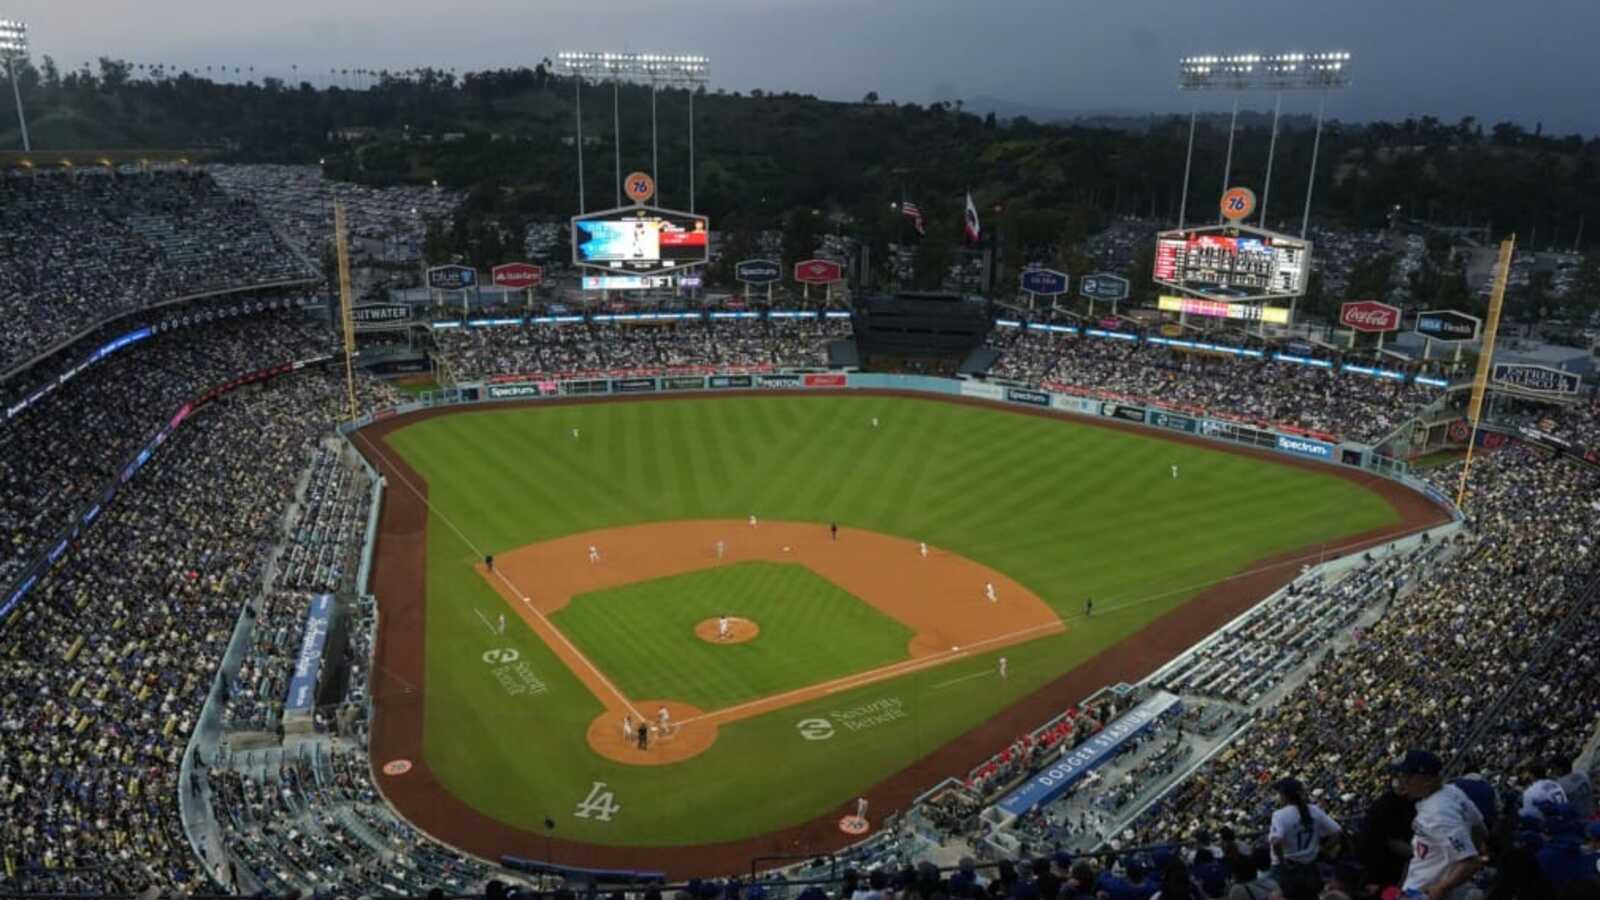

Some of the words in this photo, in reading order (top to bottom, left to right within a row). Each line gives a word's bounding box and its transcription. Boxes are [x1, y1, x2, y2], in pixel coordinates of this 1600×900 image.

[633, 180, 648, 194] 76
[1229, 196, 1245, 211] 76
[1344, 306, 1393, 326] Coca-Cola
[1278, 436, 1329, 456] Spectrum
[1038, 746, 1096, 788] DODGER
[573, 781, 621, 821] LA
